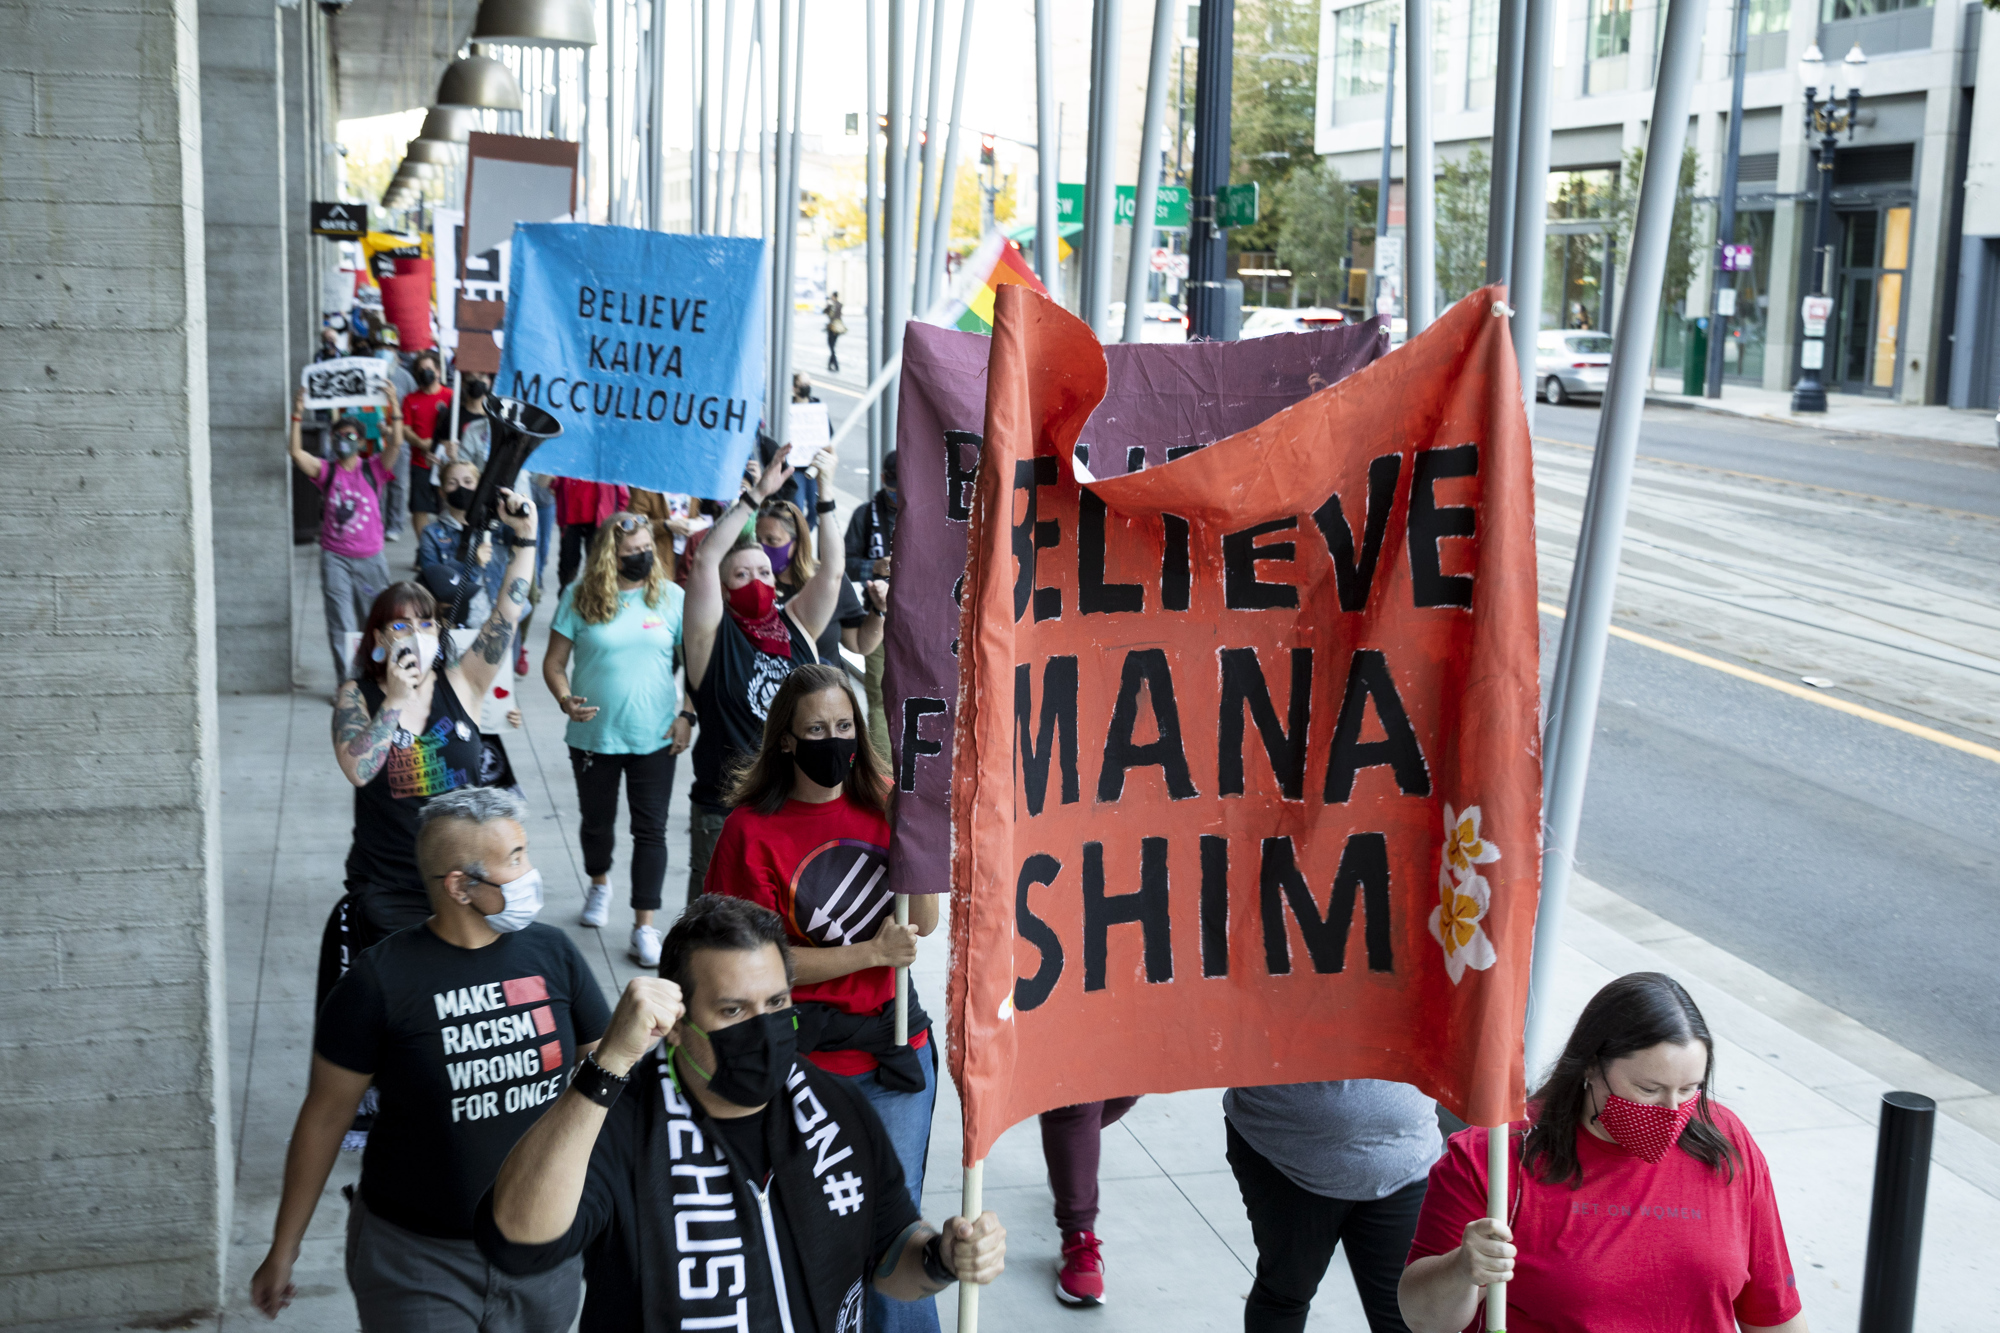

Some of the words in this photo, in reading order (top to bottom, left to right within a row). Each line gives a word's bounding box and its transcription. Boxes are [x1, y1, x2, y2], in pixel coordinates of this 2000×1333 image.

[579, 286, 708, 333] BELIEVE
[588, 335, 683, 378] KAIYA
[512, 370, 747, 432] MCCULLOUGH
[1013, 646, 1433, 822] MANA
[1013, 832, 1394, 1012] SHIM
[433, 981, 506, 1020] MAKE
[441, 1011, 537, 1055] RACISM
[446, 1048, 540, 1091] WRONG
[451, 1091, 500, 1123] FOR
[504, 1074, 562, 1114] ONCE
[1571, 1201, 1599, 1215] BET
[1608, 1204, 1632, 1217] ON
[1640, 1205, 1703, 1220] WOMEN
